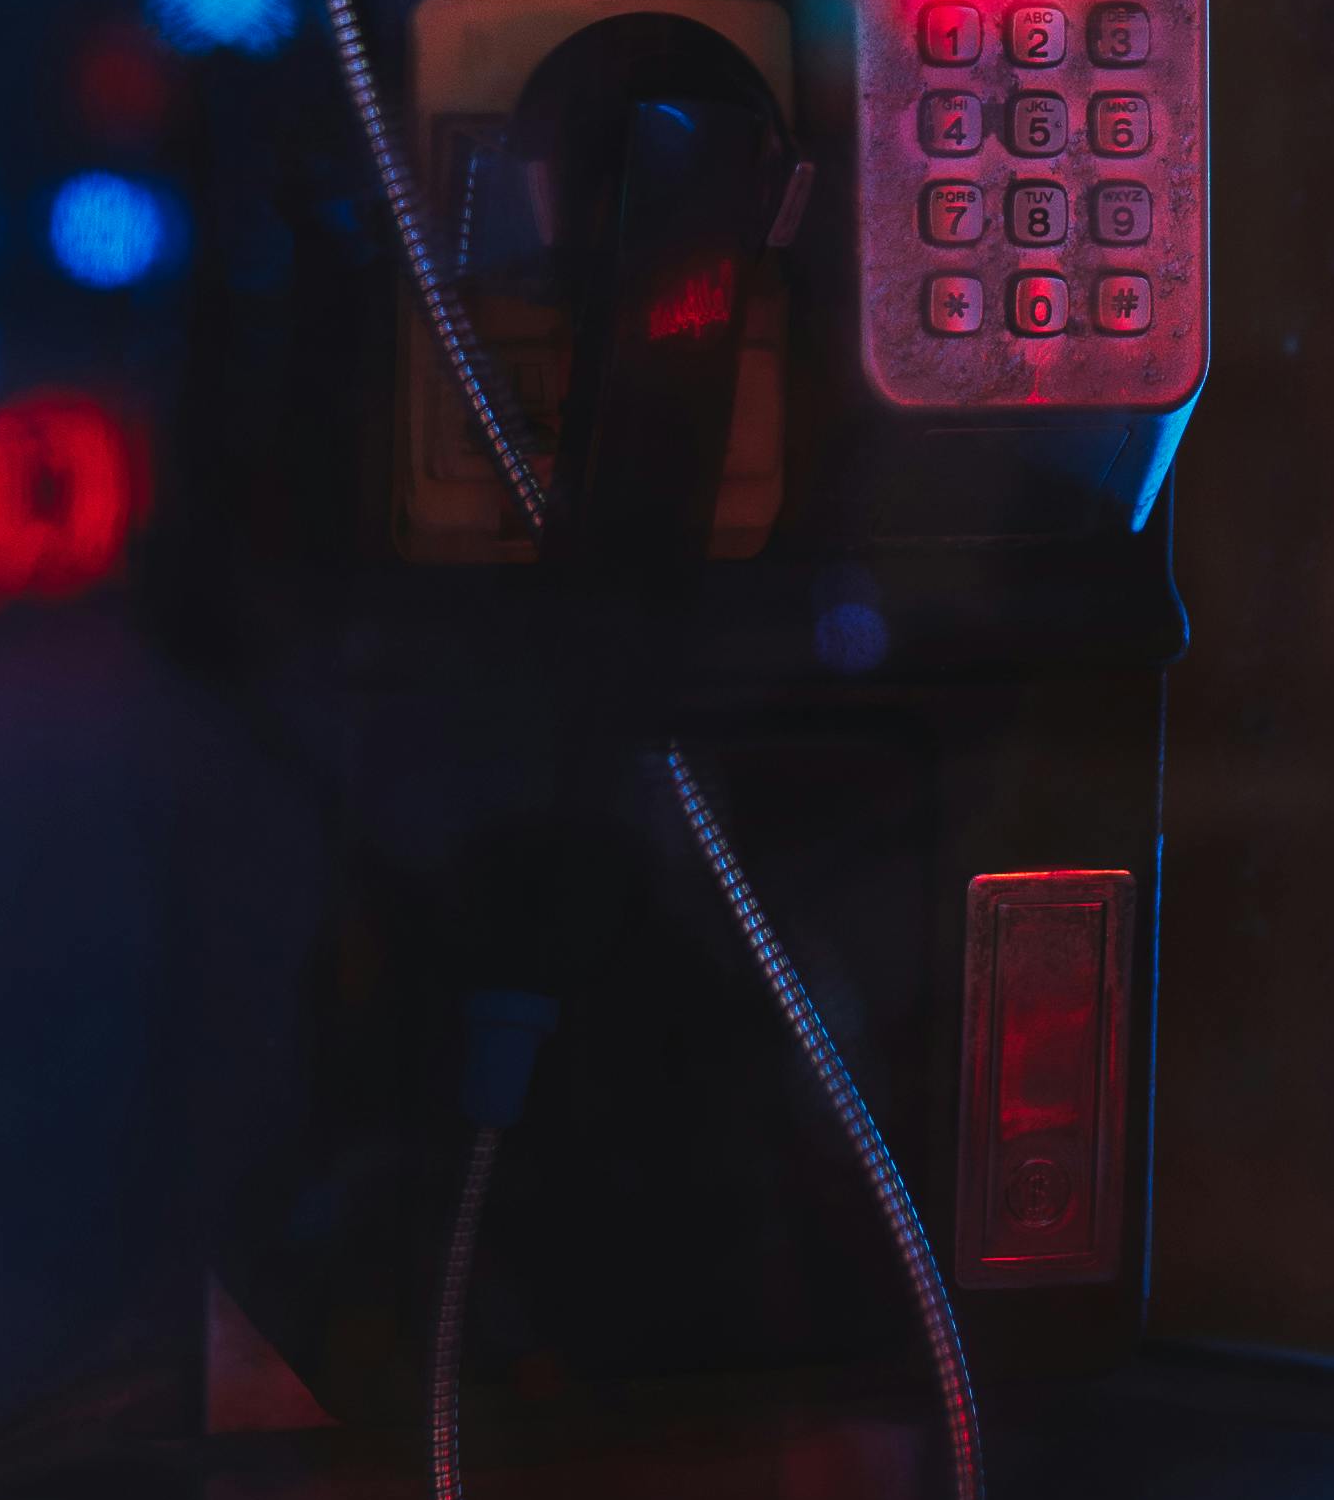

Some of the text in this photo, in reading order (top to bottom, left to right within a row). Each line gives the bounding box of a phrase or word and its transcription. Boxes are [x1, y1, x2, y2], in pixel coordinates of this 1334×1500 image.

[1023, 11, 1053, 24] ABC
[1107, 8, 1137, 23] DEF
[946, 26, 959, 57] 1
[1027, 28, 1049, 58] 2
[1110, 27, 1132, 58] 3
[942, 100, 967, 111] GHI
[1025, 101, 1054, 113] JKL
[1105, 101, 1139, 113] MNO
[942, 116, 967, 145] 4
[1028, 116, 1051, 147] 5
[1112, 118, 1134, 148] 6
[935, 190, 977, 203] PQRS
[1024, 191, 1055, 204] TUV
[1102, 190, 1143, 203] WXYZ
[945, 206, 968, 236] 7
[1027, 207, 1051, 237] 8
[1111, 206, 1135, 237] 9
[1030, 295, 1052, 327] 0
[1111, 287, 1139, 319] #
